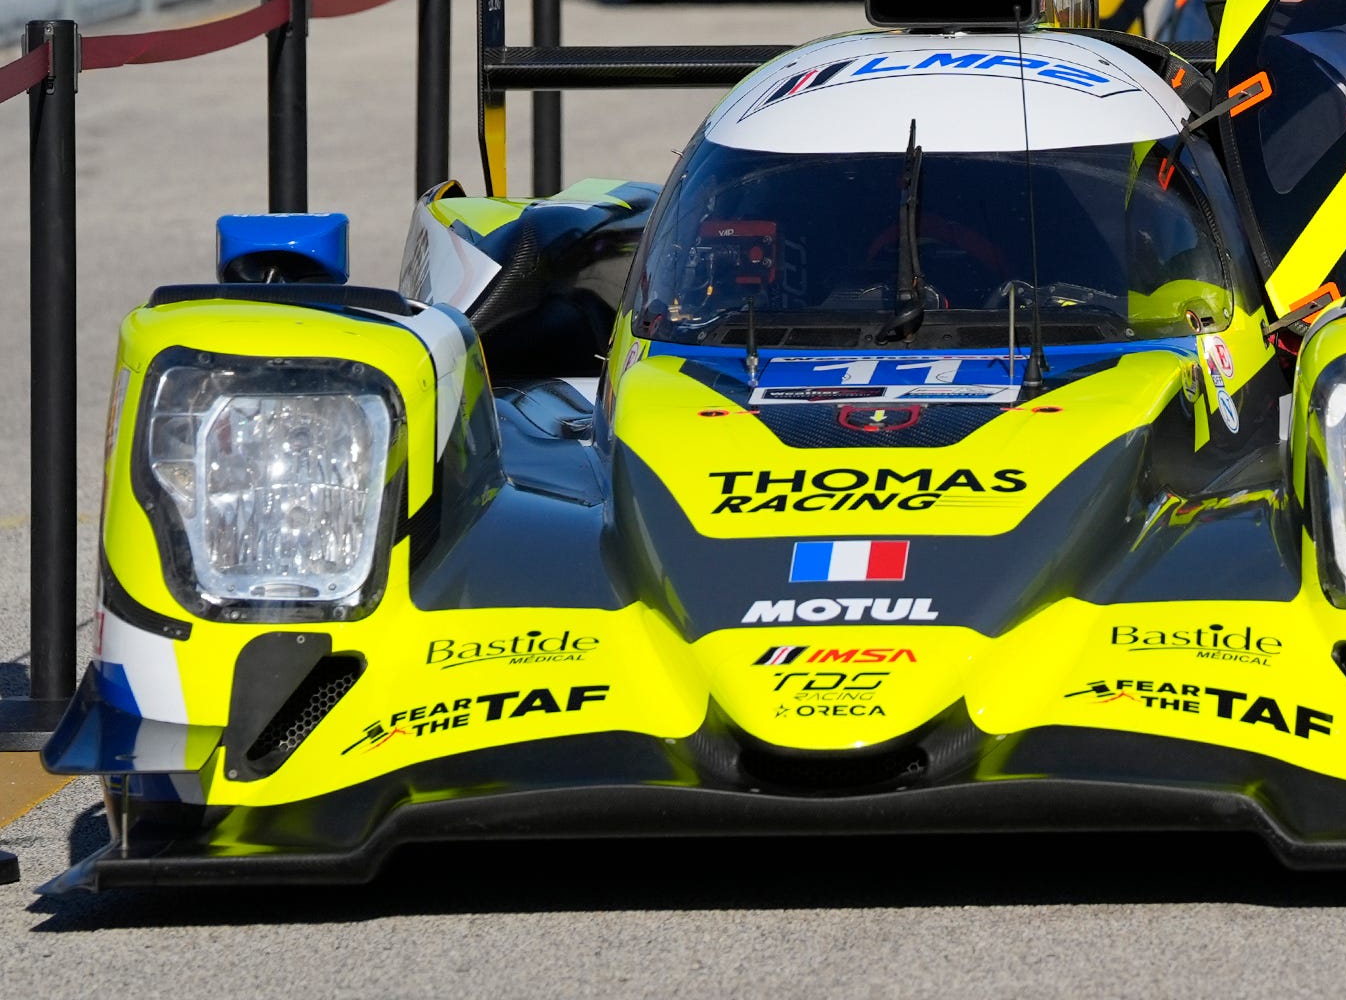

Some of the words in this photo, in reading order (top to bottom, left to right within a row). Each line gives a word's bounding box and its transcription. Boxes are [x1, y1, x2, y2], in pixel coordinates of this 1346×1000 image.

[850, 53, 1110, 87] LMP2
[813, 360, 962, 385] 11
[708, 468, 1027, 494] THOMAS
[711, 492, 942, 513] RACING
[741, 598, 939, 623] MOTUL
[426, 630, 600, 665] Bastide
[1111, 624, 1283, 655] Bastide
[508, 654, 585, 665] MÉDICAL
[806, 649, 917, 663] IMSA
[1196, 650, 1272, 667] MÉDICAL
[773, 672, 890, 692] TDS
[1116, 679, 1200, 697] FEAR
[794, 692, 876, 701] RACING
[390, 698, 472, 727] FEAR
[412, 713, 470, 737] THE
[477, 685, 610, 722] TAF
[797, 705, 886, 717] ORECA
[1140, 695, 1200, 713] THE
[1205, 687, 1334, 739] TAF
